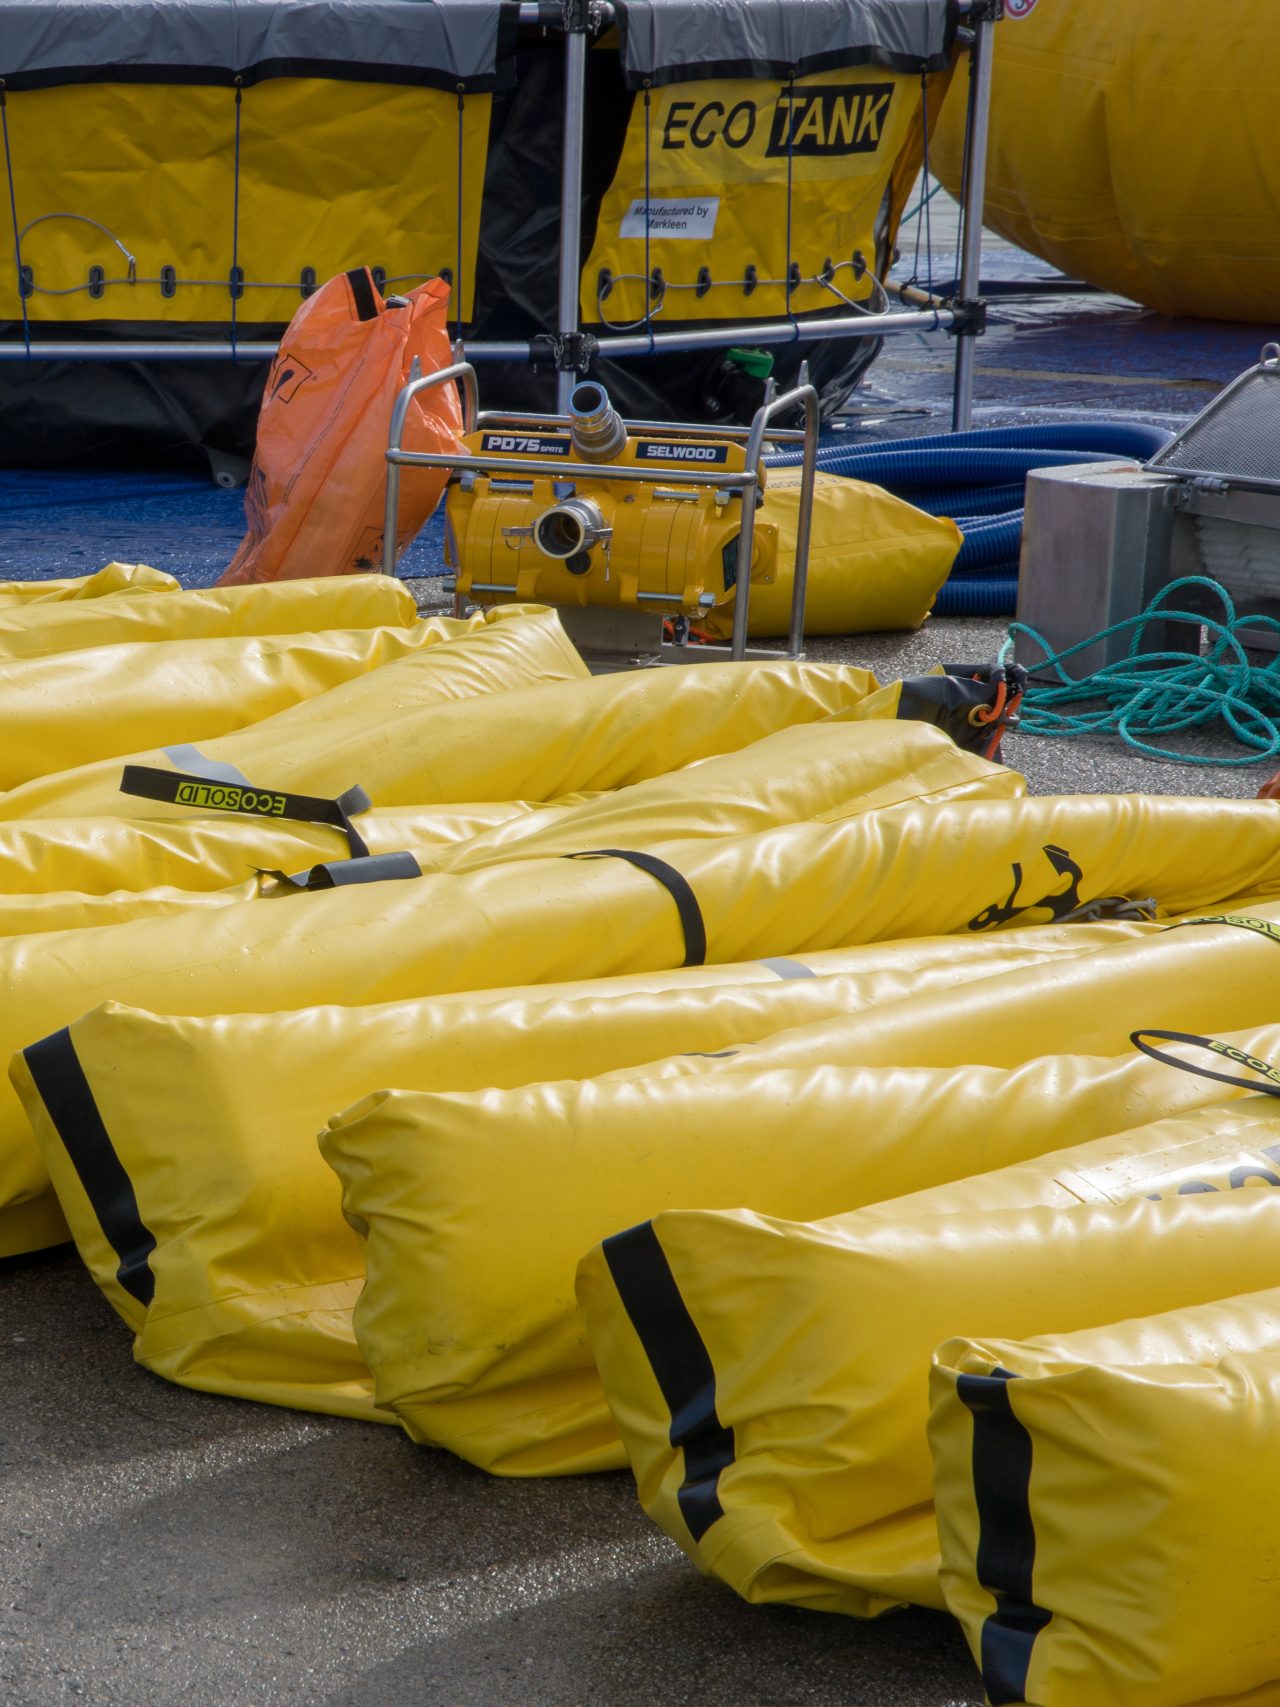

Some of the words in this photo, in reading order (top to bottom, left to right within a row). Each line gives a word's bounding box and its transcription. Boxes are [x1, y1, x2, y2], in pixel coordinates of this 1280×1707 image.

[661, 100, 757, 150] ECO
[777, 93, 891, 146] TANK
[633, 204, 696, 217] Manufactured
[696, 205, 709, 218] by
[647, 219, 688, 230] Markleen
[487, 436, 540, 452] PD75
[540, 445, 564, 453] SPATE
[646, 445, 716, 460] SELWOOD
[178, 784, 287, 815] ECOSOLID
